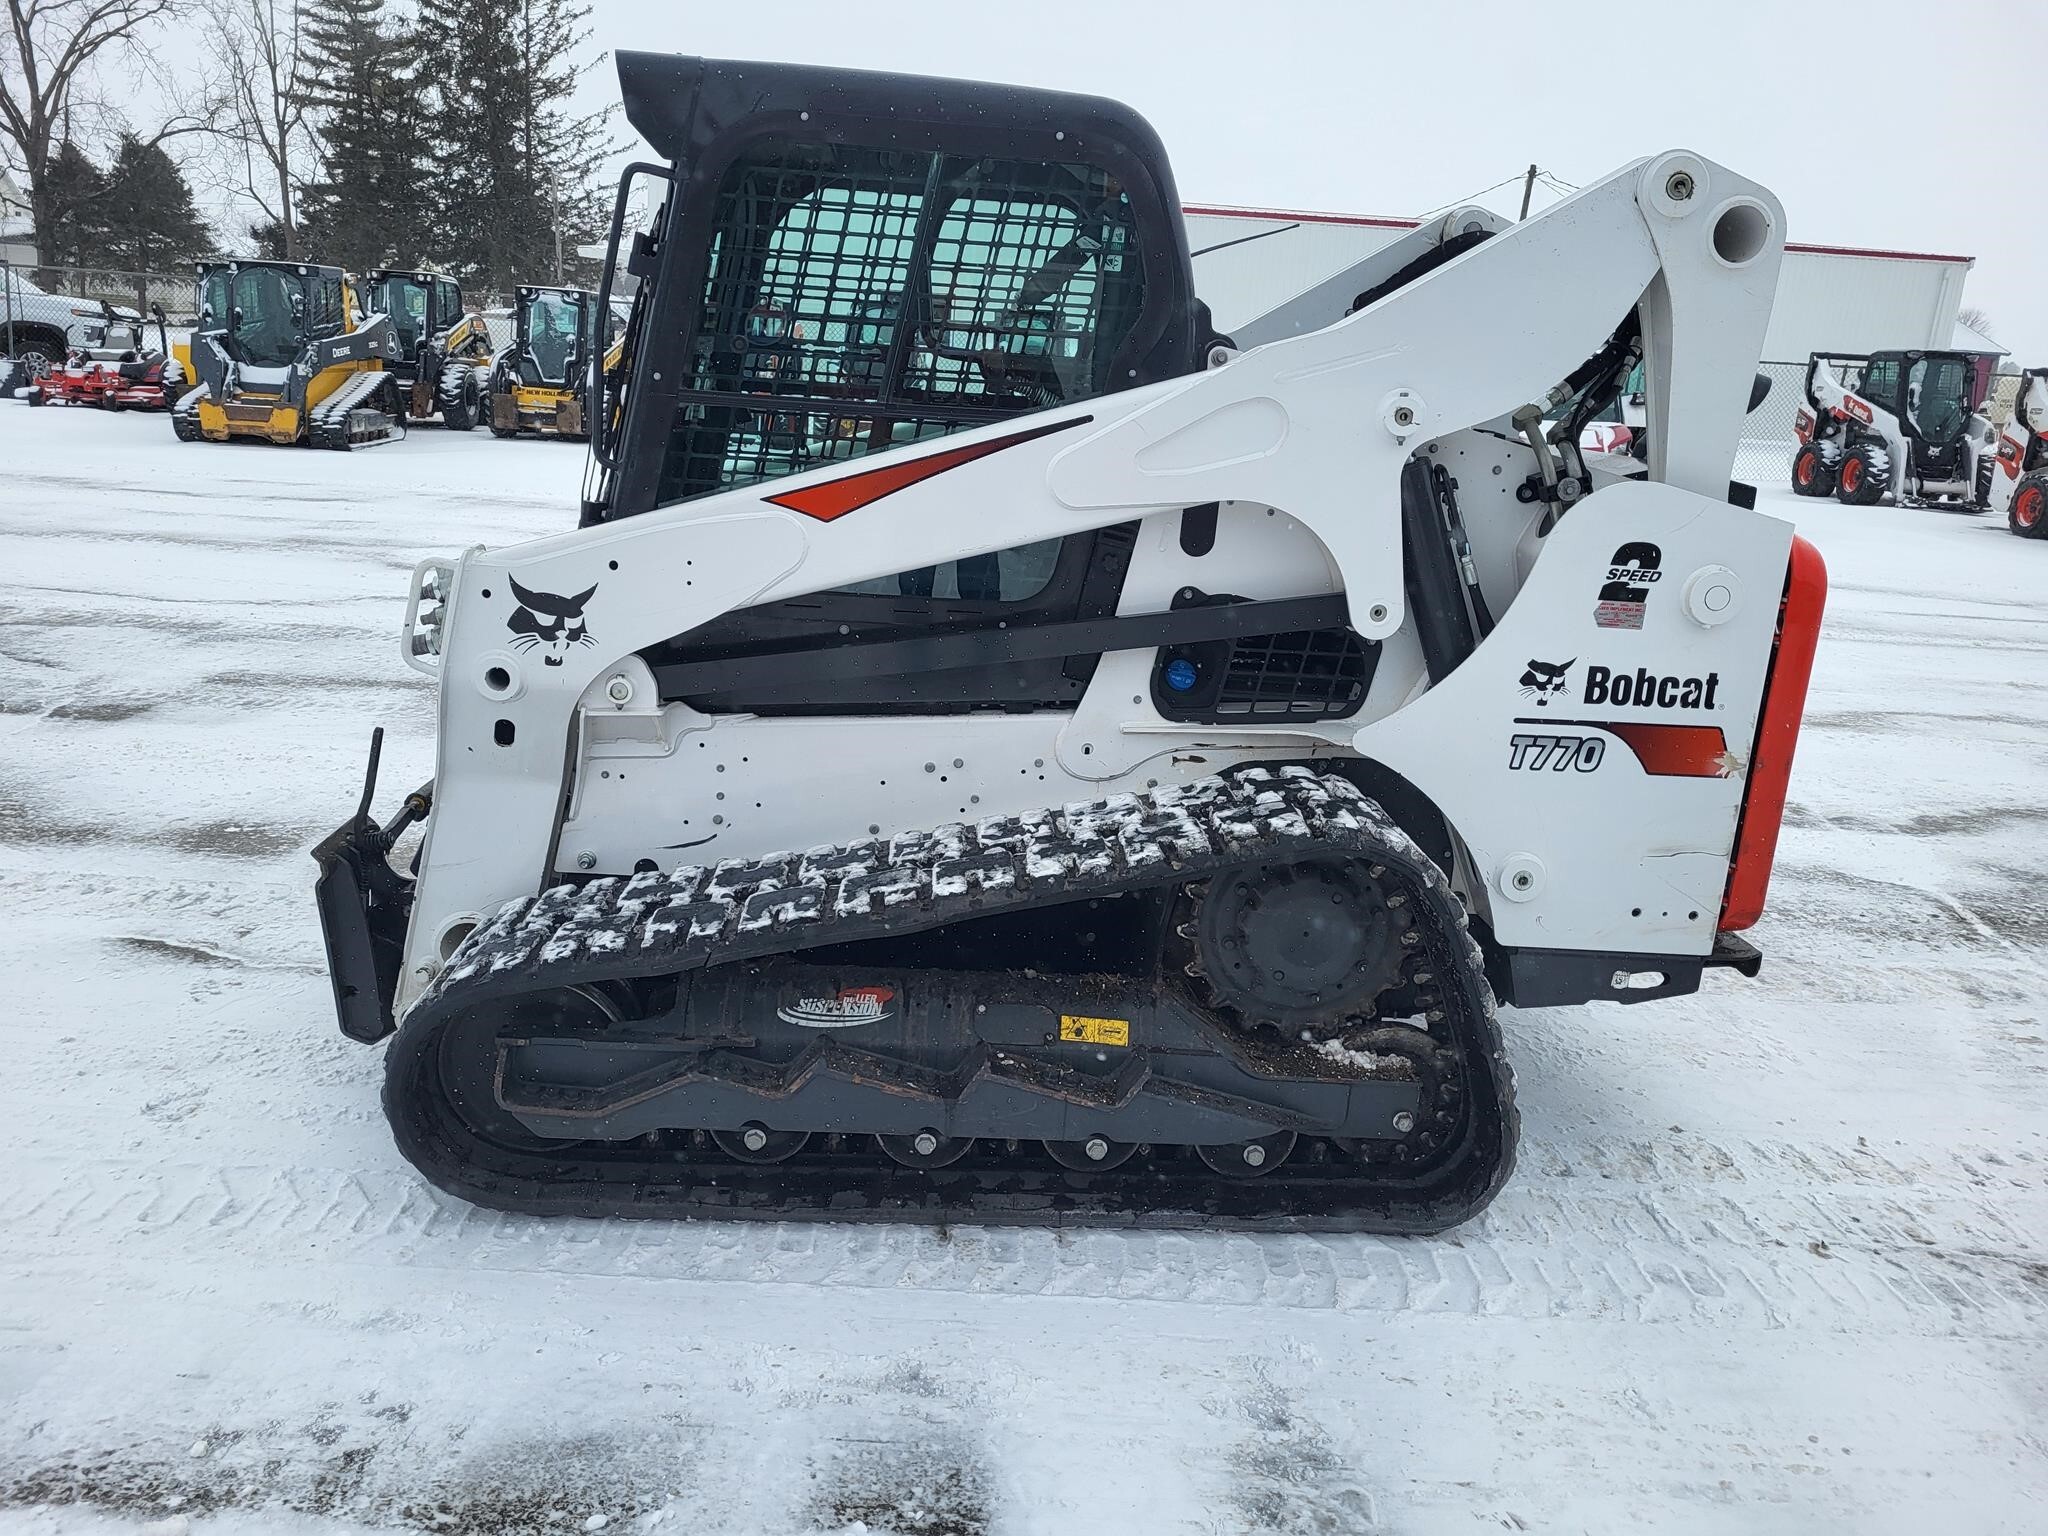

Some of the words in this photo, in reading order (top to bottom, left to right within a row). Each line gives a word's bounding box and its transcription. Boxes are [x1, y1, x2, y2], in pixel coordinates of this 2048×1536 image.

[332, 346, 351, 358] DEERE
[1605, 568, 1663, 583] SPEED
[1583, 665, 1719, 711] Bobcat
[1508, 734, 1607, 774] T770
[799, 998, 884, 1016] SUSPENSION
